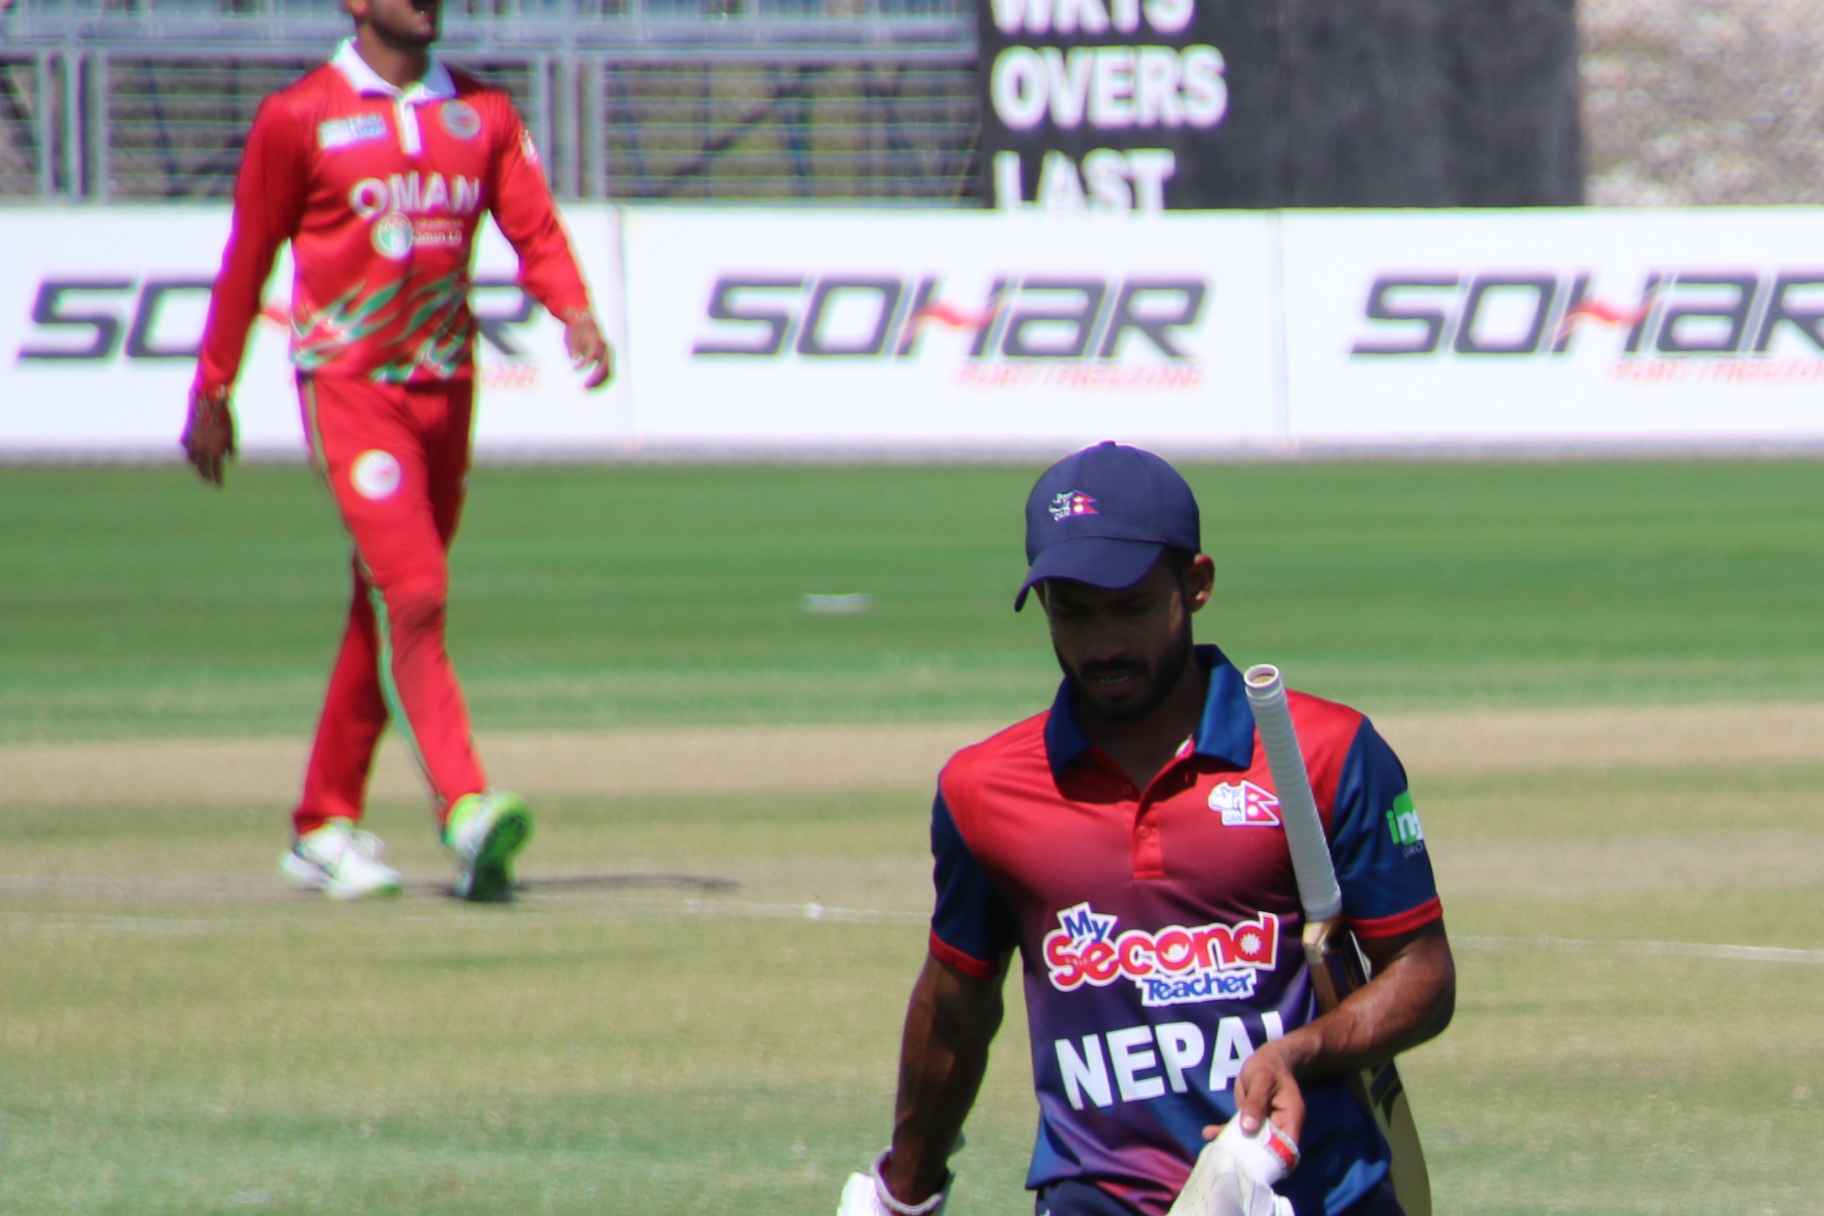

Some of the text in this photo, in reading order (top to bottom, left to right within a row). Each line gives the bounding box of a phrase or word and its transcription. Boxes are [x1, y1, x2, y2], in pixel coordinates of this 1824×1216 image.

[991, 44, 1227, 129] OVERS
[349, 170, 480, 219] OMAN
[993, 147, 1175, 212] LAST
[17, 278, 537, 358] SOR
[1046, 913, 1276, 988] Second
[1062, 907, 1112, 943] My
[1141, 969, 1251, 1001] Teacher
